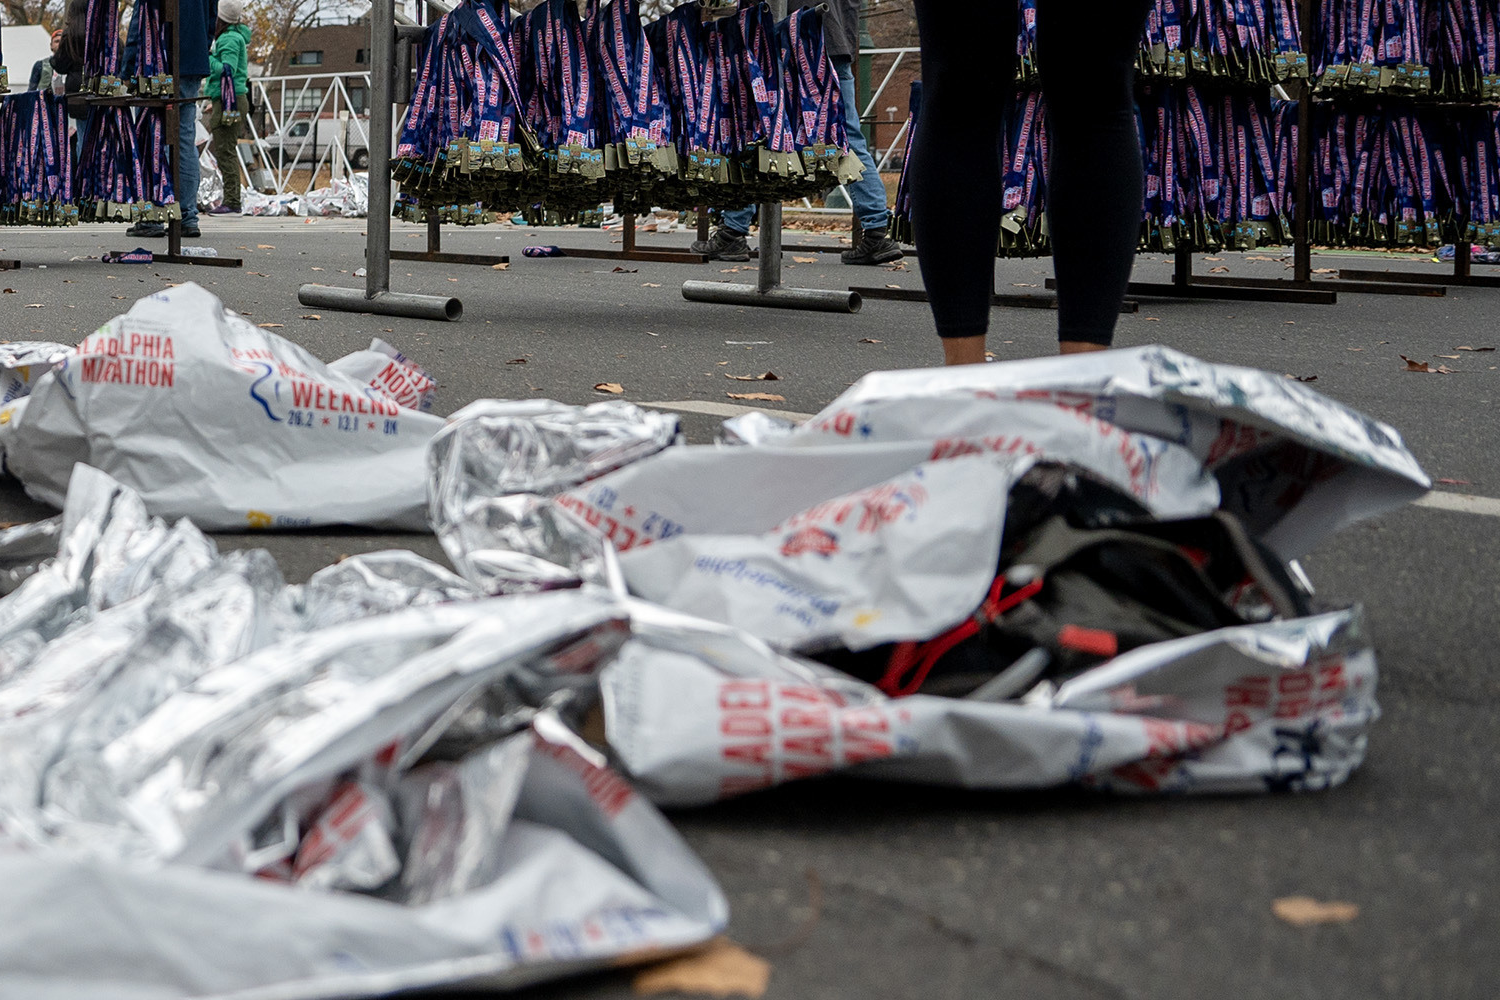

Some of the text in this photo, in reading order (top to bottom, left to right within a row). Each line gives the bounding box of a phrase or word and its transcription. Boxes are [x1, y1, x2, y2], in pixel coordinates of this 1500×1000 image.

[477, 8, 497, 34] WEEKEND
[410, 79, 427, 117] PHILADELPHIA
[607, 69, 627, 105] PHILADELPHIA
[638, 64, 649, 100] PHILADELPHIA
[291, 380, 399, 417] WEEKEND
[287, 409, 399, 435] 26.2 13.1 8K
